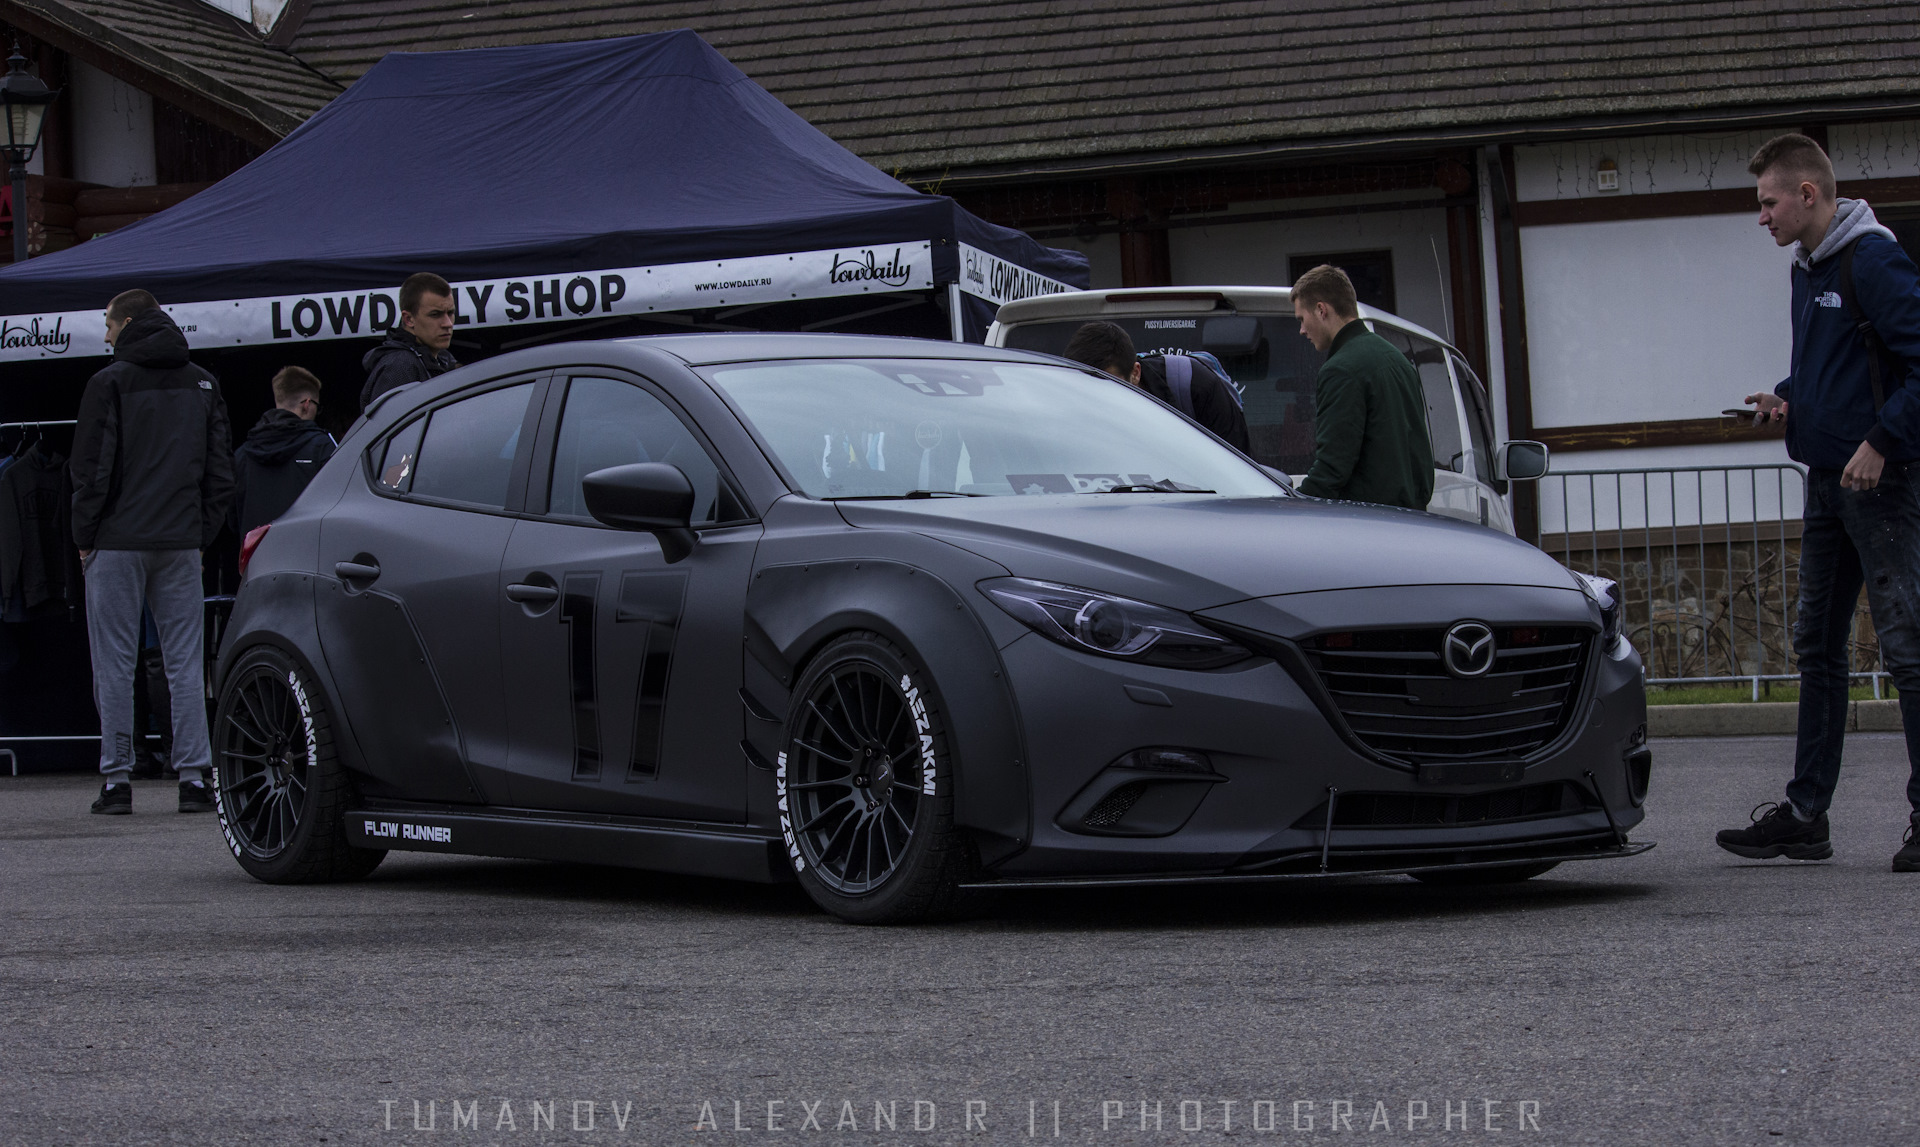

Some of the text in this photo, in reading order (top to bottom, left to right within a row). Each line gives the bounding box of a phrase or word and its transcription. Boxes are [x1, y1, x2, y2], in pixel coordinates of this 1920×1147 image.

[272, 274, 627, 339] LOWDLY SHOP
[694, 277, 772, 292] WWW.LOWDAILY.RU
[559, 569, 691, 783] 17
[364, 820, 452, 843] FLOW RUNNER
